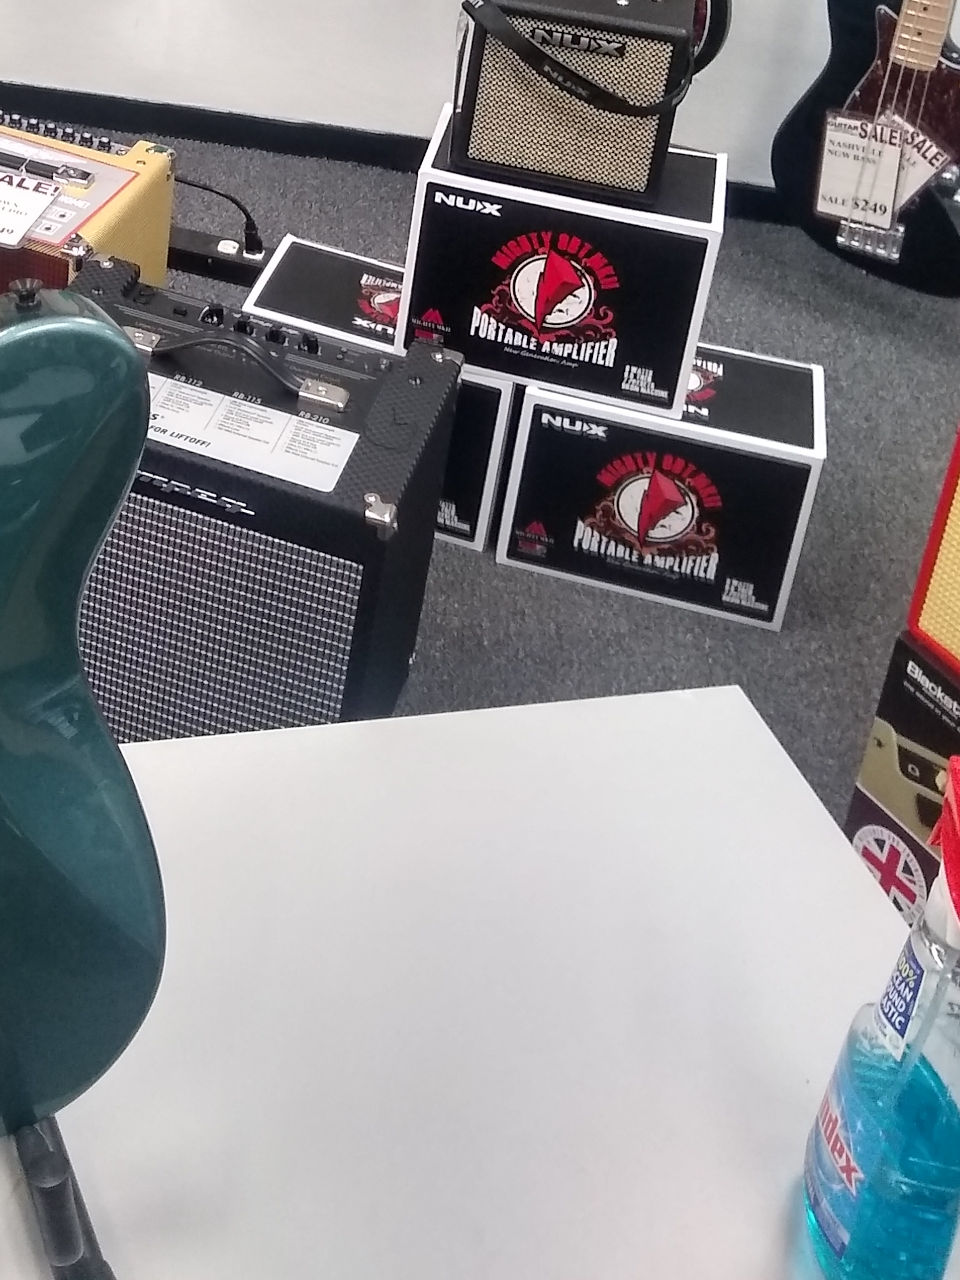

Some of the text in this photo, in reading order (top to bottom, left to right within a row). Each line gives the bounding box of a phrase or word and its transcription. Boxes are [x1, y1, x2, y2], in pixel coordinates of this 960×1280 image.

[534, 28, 625, 57] NUX
[828, 121, 902, 148] GUITAR SALE!
[904, 129, 947, 170] SALE!
[434, 191, 503, 217] NUX
[821, 194, 887, 216] SALE $249
[491, 231, 553, 270] MIGHTY
[351, 315, 396, 335] UX
[470, 305, 618, 368] PORTABLE AMPLIFIER
[174, 373, 204, 388] RB-112
[693, 358, 724, 377] PORTA
[232, 390, 263, 405] RB-115
[298, 409, 330, 425] RB-210
[541, 412, 609, 439] NUX
[148, 424, 212, 448] FOR LIFTOFF!
[573, 519, 639, 562] PORTABLE
[643, 552, 720, 581] AMPLIFIER
[892, 972, 913, 1003] CEAN
[880, 996, 905, 1030] ASTIC
